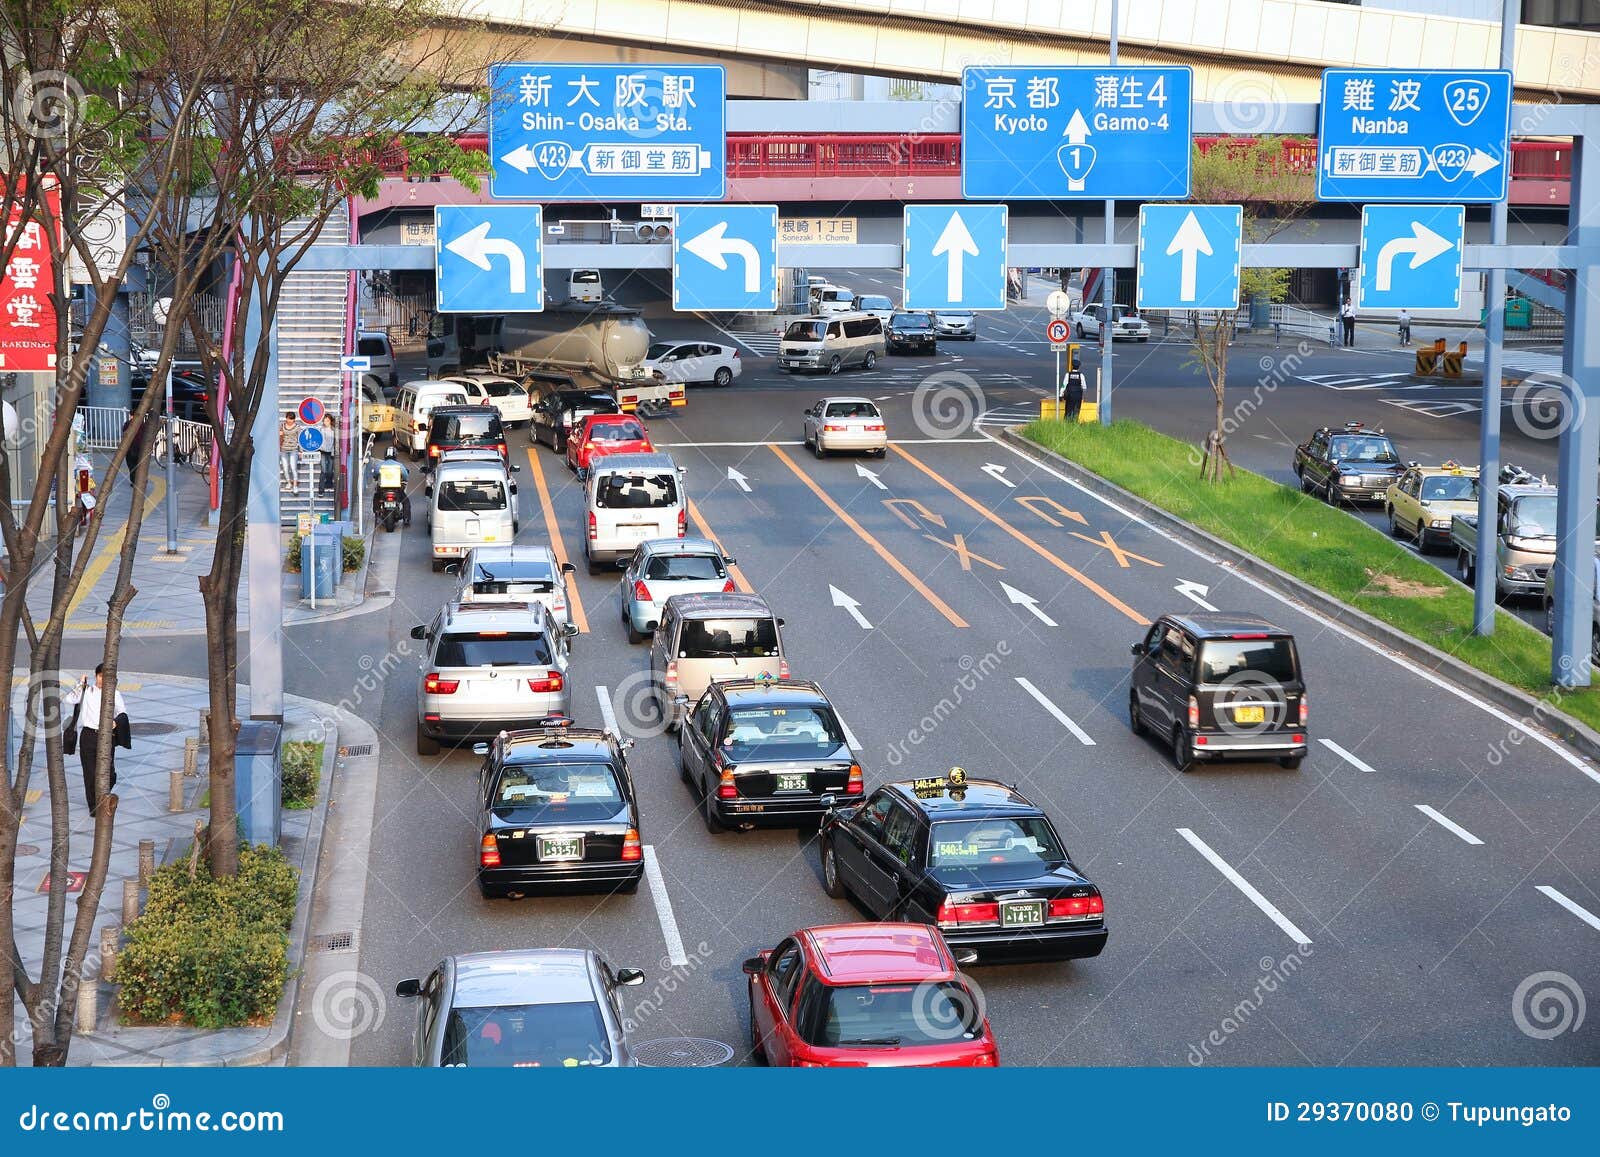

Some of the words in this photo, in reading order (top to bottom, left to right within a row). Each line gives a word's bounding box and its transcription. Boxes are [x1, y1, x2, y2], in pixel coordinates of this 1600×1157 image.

[519, 73, 697, 108] 新大阪駅
[983, 75, 1060, 109] 京都
[1094, 75, 1168, 109] 蒲生4
[1342, 78, 1421, 112] 難波
[1452, 88, 1480, 111] 25
[656, 112, 693, 131] Sta.
[994, 113, 1048, 134] Kyoto
[1093, 112, 1169, 131] Gamo-4
[1352, 116, 1409, 134] Nanba
[539, 146, 566, 167] 423
[596, 150, 692, 169] 新御堂筋
[1069, 148, 1080, 169] 1
[1338, 153, 1417, 172] 新御堂筋
[1437, 153, 1465, 168] 423
[1013, 911, 1039, 922] 14-12
